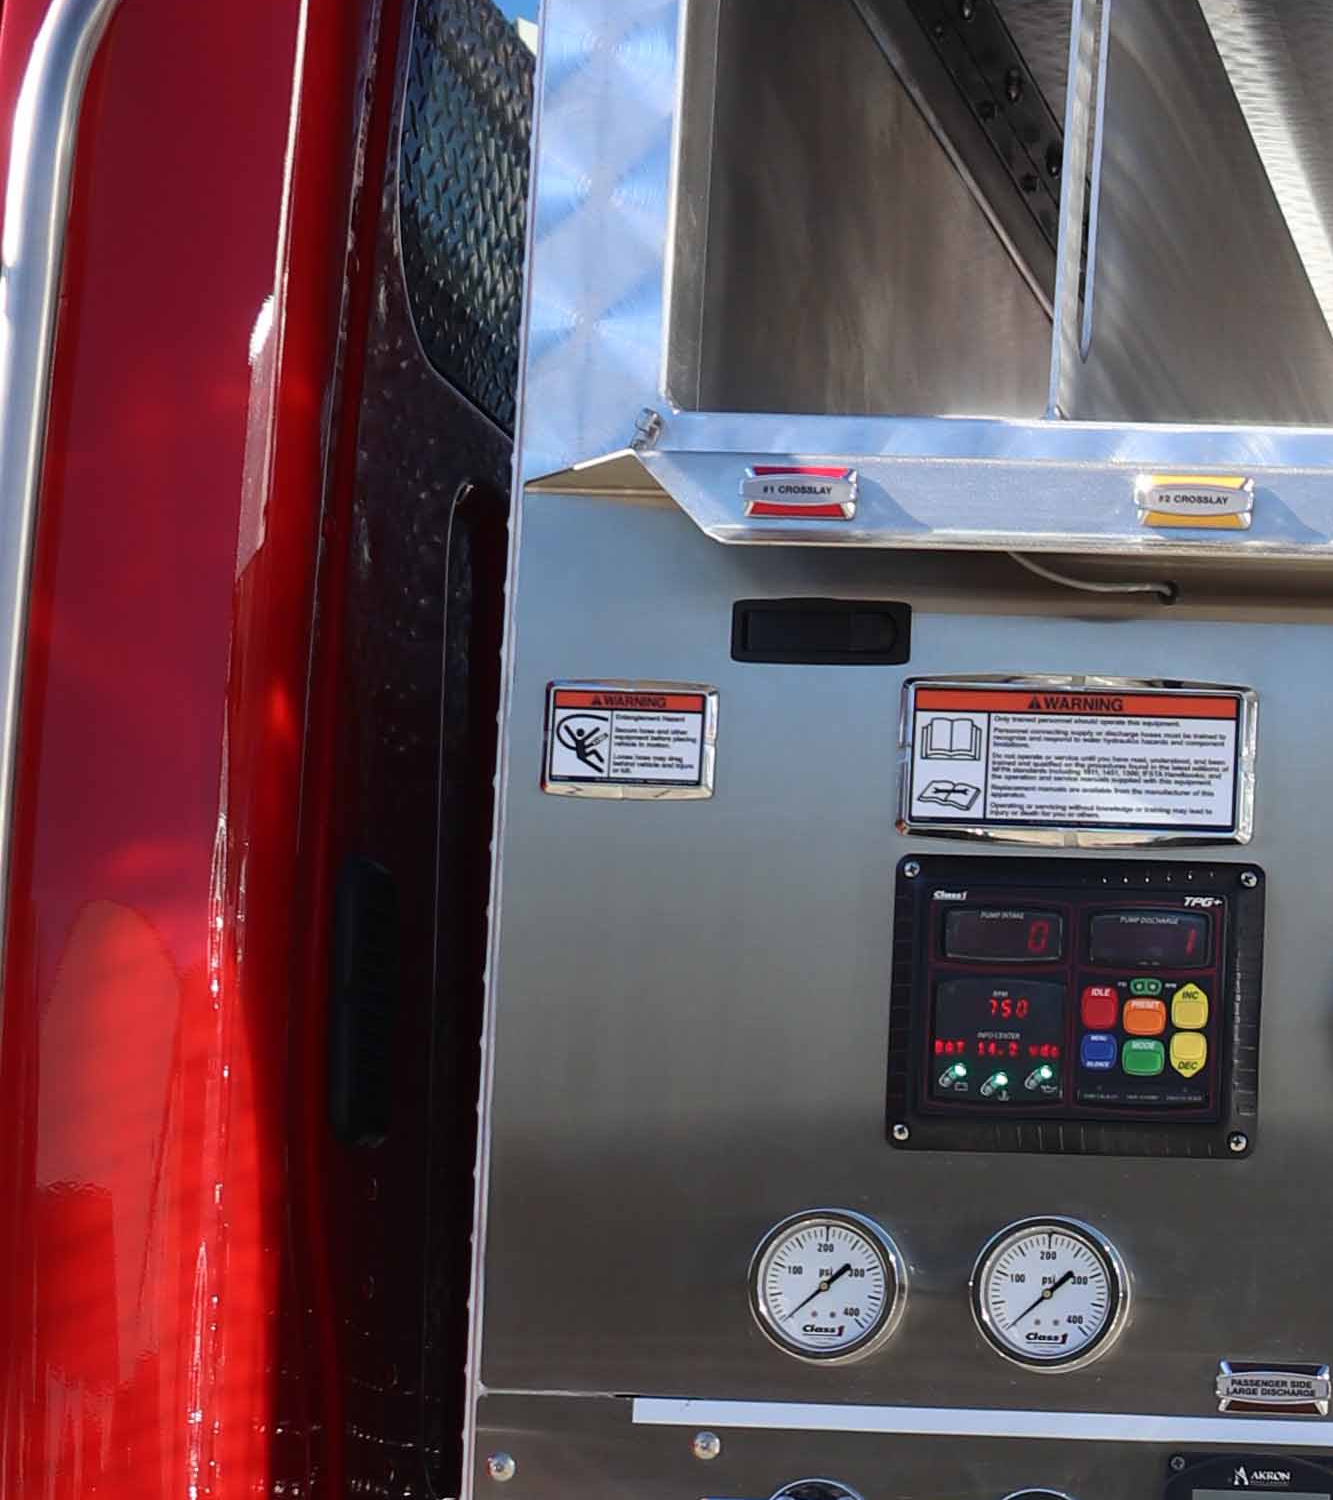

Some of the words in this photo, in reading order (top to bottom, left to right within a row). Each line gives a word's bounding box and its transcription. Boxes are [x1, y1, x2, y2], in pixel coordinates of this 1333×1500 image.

[763, 485, 774, 495] #1
[778, 485, 832, 495] CROSSLAY
[1159, 495, 1171, 504] #2
[1174, 495, 1229, 505] CROSSLAY
[1043, 697, 1123, 711] WARNING
[1184, 896, 1223, 908] TPG+
[1091, 988, 1111, 997] IDLE
[1182, 991, 1199, 1000] INC
[989, 998, 1029, 1019] 750
[1178, 1061, 1198, 1070] DEC
[817, 1243, 834, 1252] 200
[787, 1266, 803, 1275] 100
[802, 1324, 845, 1336] Class1
[1025, 1332, 1069, 1344] Class1
[1231, 1379, 1288, 1389] PASSENGER
[1291, 1381, 1312, 1389] SIDE
[1226, 1387, 1258, 1397] LARGE
[1261, 1388, 1316, 1398] DISCHARGE
[1250, 1471, 1291, 1481] AKRON
